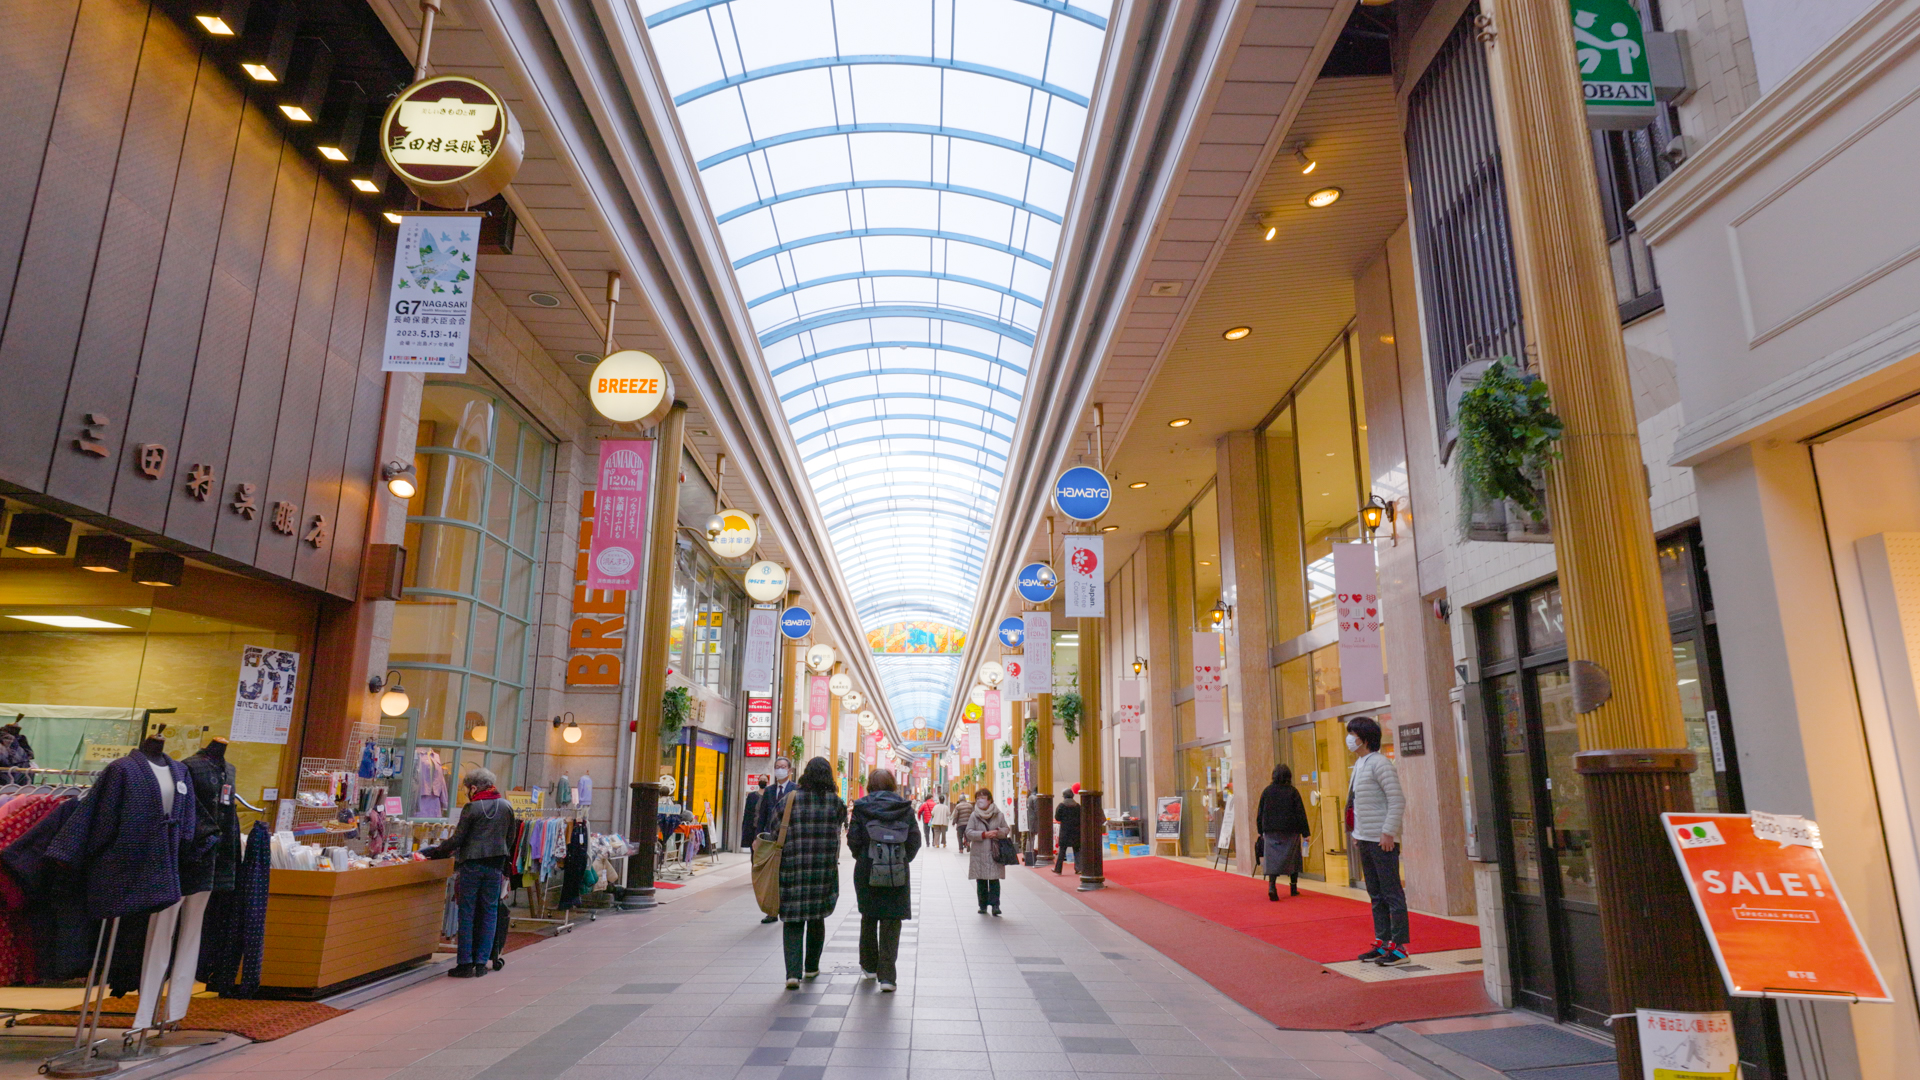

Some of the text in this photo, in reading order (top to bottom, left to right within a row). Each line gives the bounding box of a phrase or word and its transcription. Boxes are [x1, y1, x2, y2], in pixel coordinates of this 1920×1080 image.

[390, 136, 492, 157] 三田村呉服店
[395, 300, 468, 315] G7 NAGASAKI
[394, 316, 466, 325] 長崎保健大臣会合
[597, 378, 659, 394] BREEZE
[603, 450, 643, 469] HAMAICHI
[71, 413, 328, 549] 三田村呉服店
[609, 475, 636, 487] 120th
[603, 496, 611, 526] 未来へと。
[615, 496, 625, 539] 笑顔あふれる
[628, 497, 638, 534] つなげます。
[1702, 870, 1825, 897] SALE!
